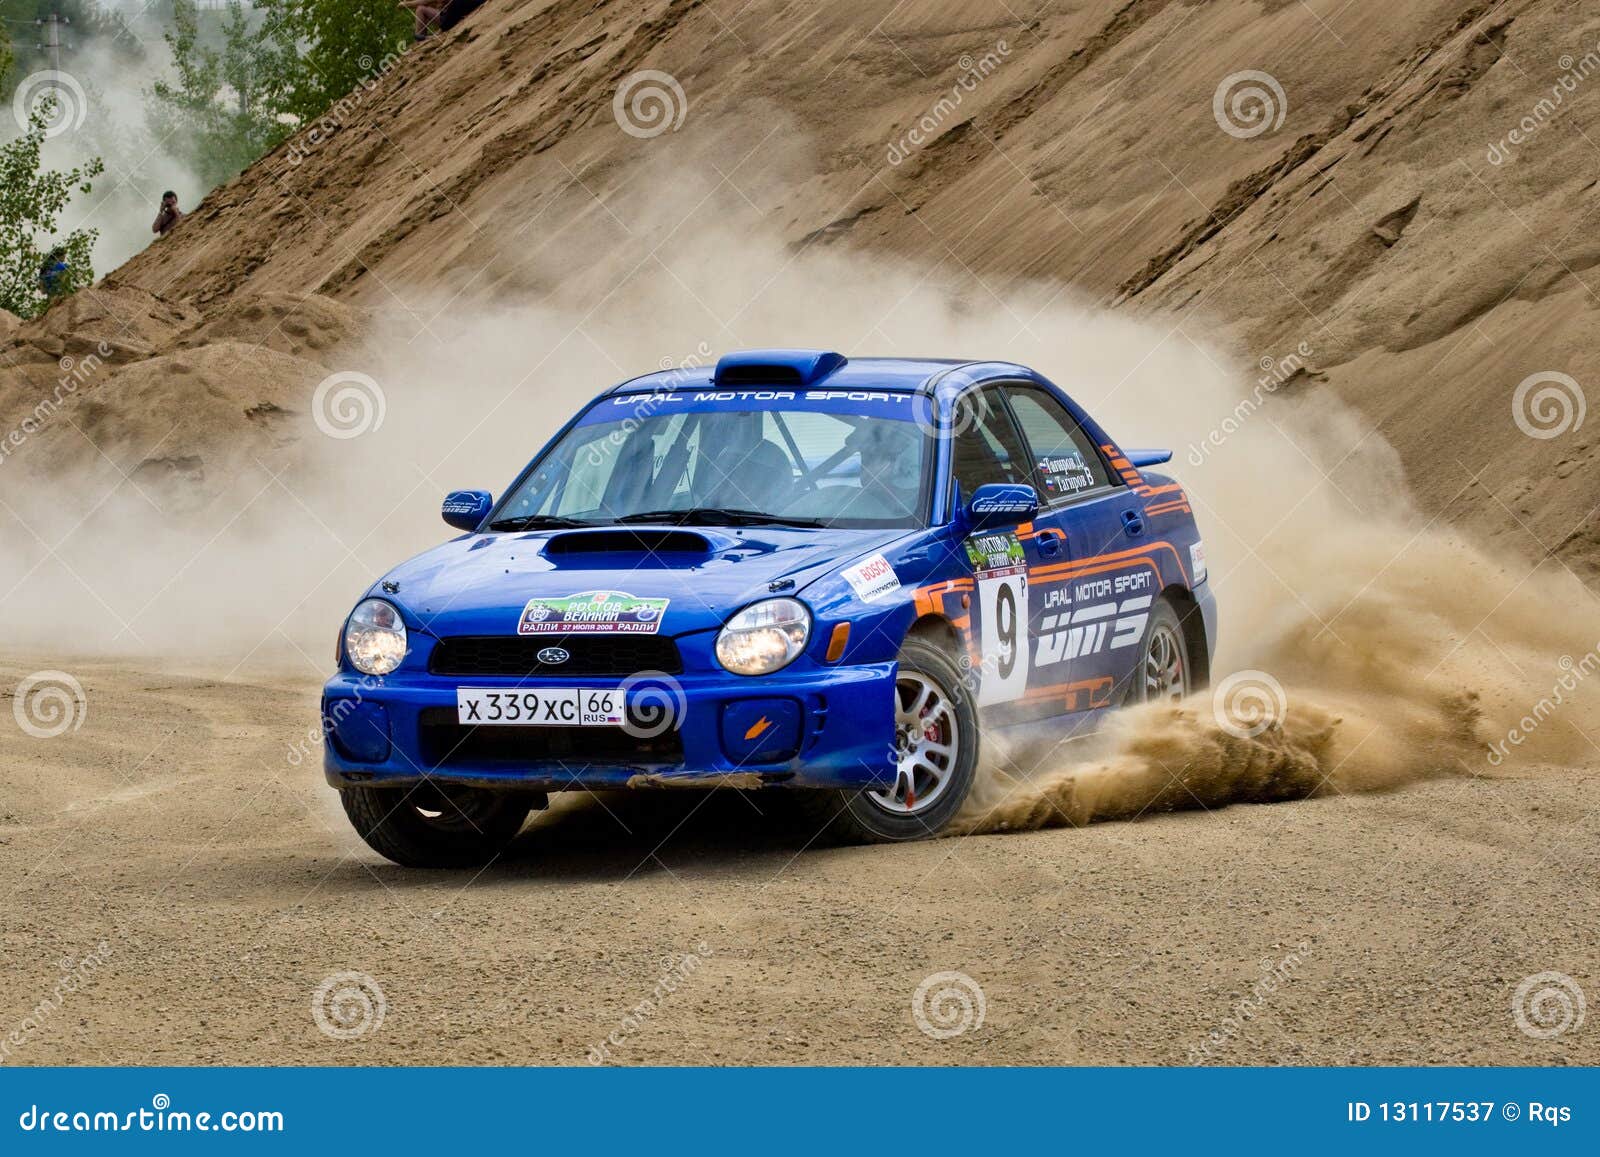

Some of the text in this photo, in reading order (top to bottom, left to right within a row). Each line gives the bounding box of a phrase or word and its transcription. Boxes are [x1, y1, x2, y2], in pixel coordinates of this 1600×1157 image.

[613, 391, 911, 405] URAL MOTOR SPORT
[859, 558, 891, 582] BOSCH
[1044, 571, 1152, 608] URAL MOTOR SPORT
[522, 623, 559, 631] РАЛЛИ
[617, 623, 655, 631] РАЛЛИ
[996, 582, 1017, 680] 9
[587, 692, 614, 713] 66
[583, 714, 606, 722] RUS
